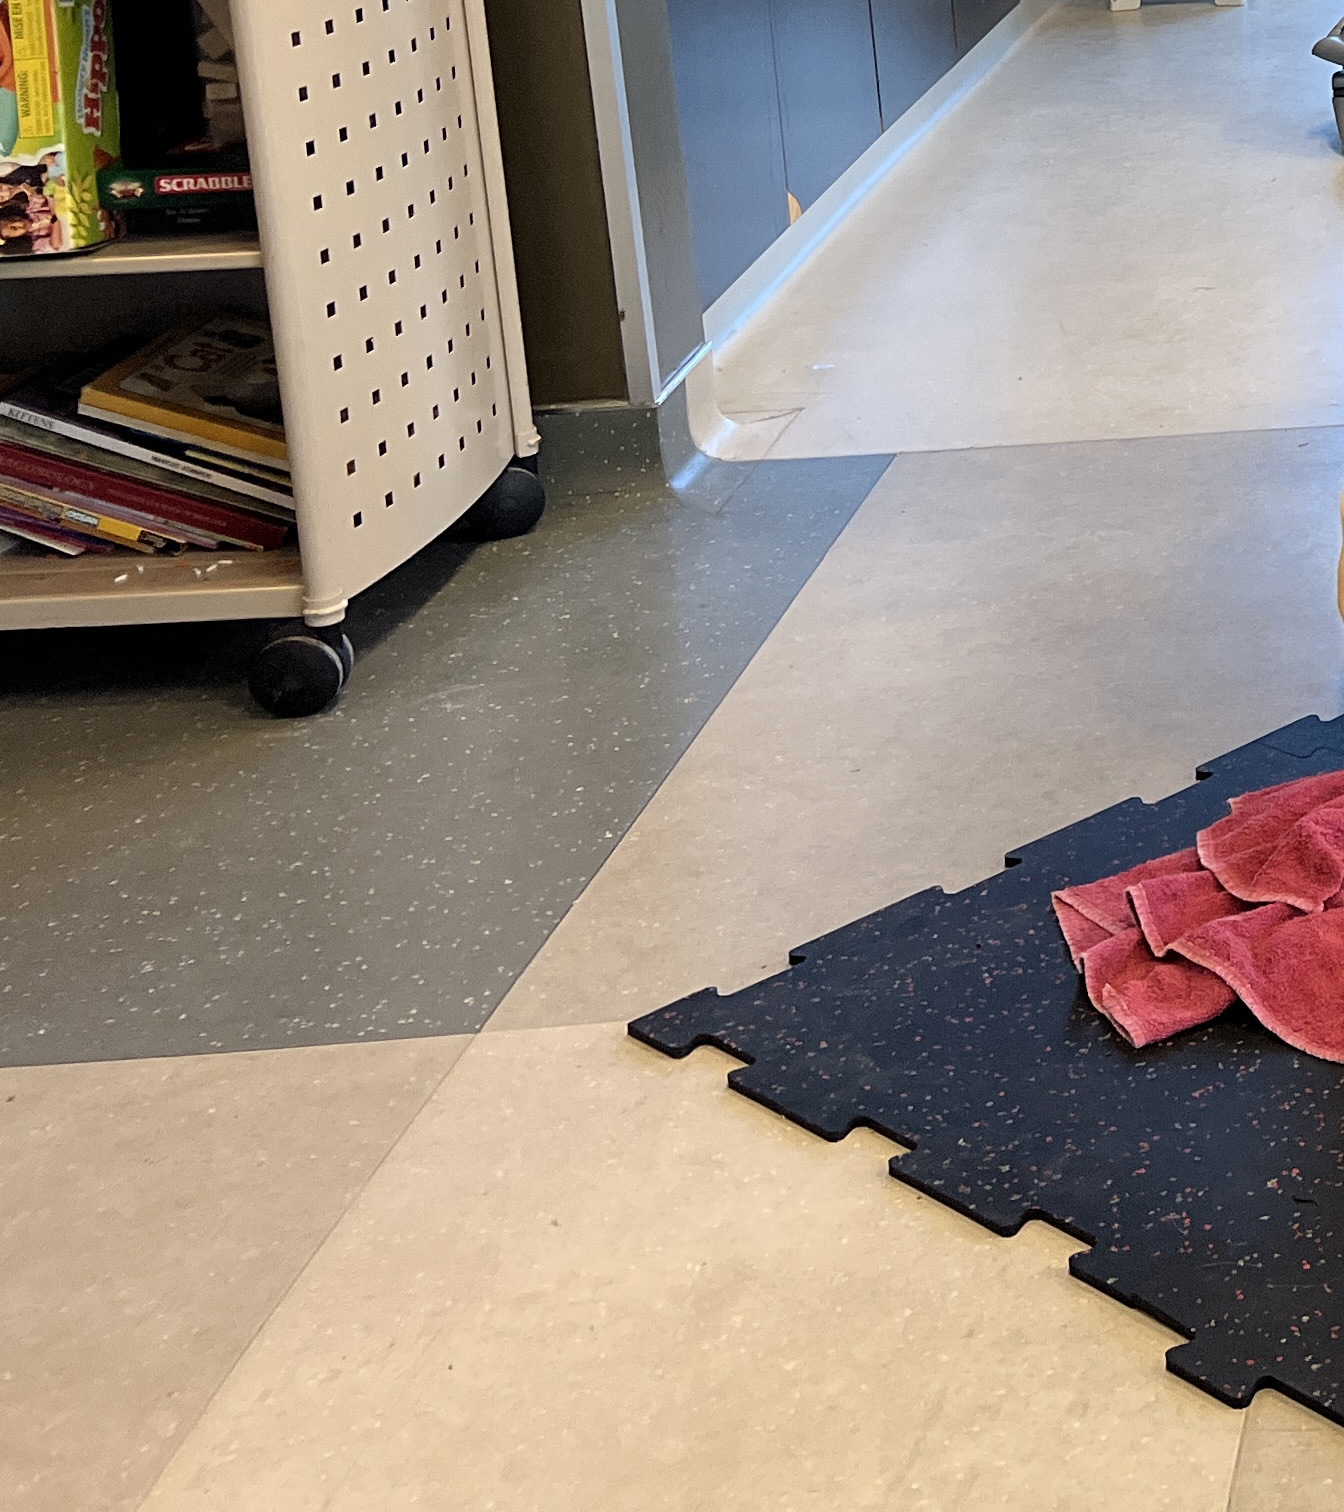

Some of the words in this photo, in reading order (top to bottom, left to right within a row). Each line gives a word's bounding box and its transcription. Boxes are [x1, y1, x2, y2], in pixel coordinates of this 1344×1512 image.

[10, 2, 22, 16] EN
[12, 16, 24, 40] MISE
[17, 70, 31, 118] WARNING:
[159, 175, 250, 192] SCRABBLE
